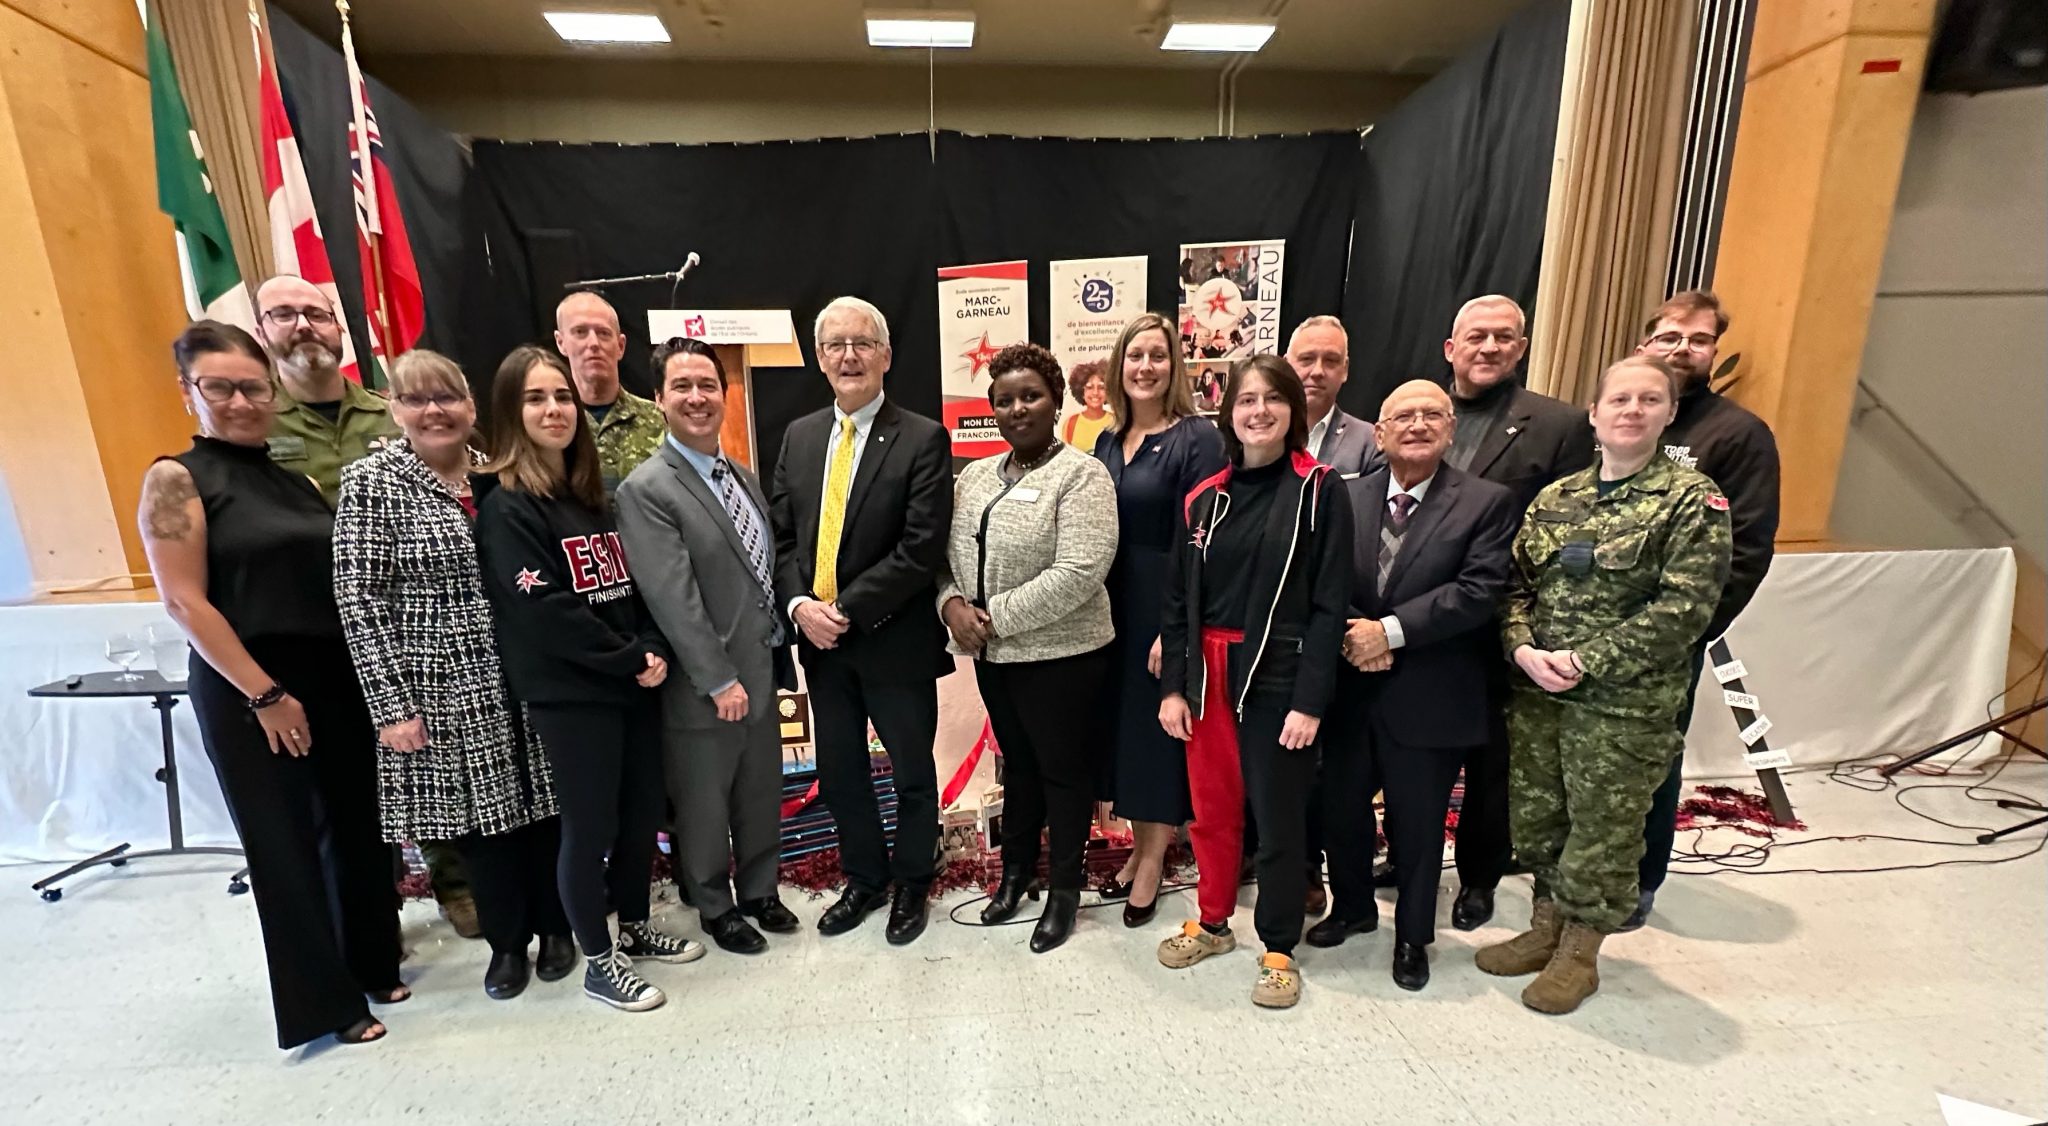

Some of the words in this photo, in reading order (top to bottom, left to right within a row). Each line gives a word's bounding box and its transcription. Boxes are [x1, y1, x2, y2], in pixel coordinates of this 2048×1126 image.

[965, 295, 1001, 307] MARC-
[1086, 281, 1110, 310] 25
[956, 306, 1011, 319] GARNEAU
[963, 419, 982, 427] MON
[957, 431, 1002, 439] FRANCOPH
[1727, 694, 1754, 705] SUPER
